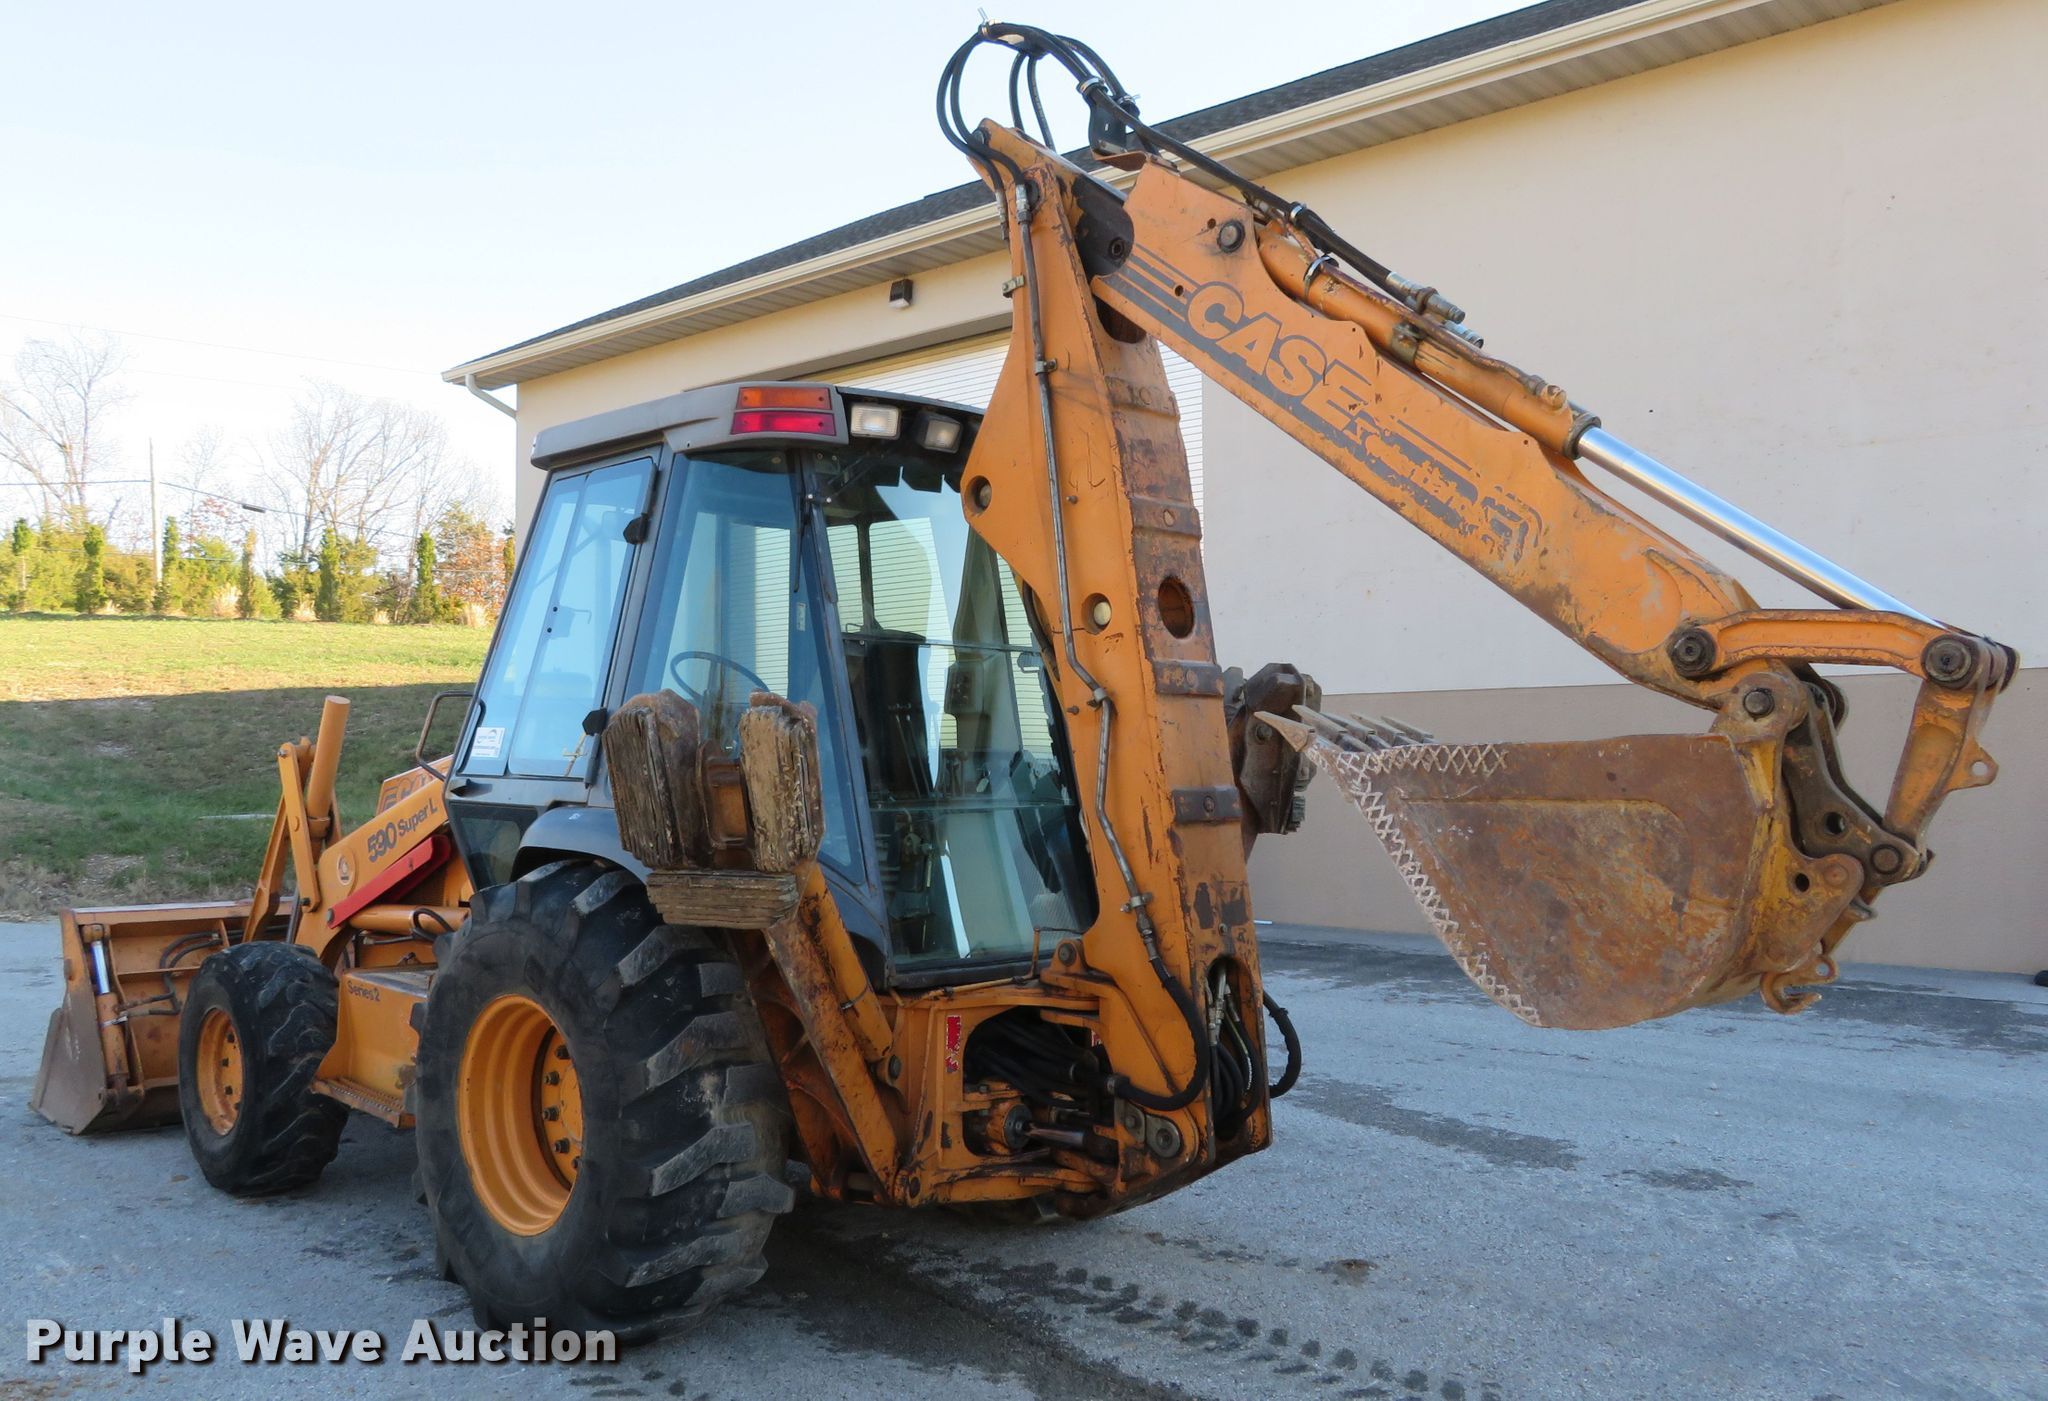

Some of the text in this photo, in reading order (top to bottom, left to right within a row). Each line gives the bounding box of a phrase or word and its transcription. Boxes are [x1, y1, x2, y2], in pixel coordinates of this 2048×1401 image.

[1187, 281, 1374, 433] CASE
[367, 798, 438, 863] 590 Super L
